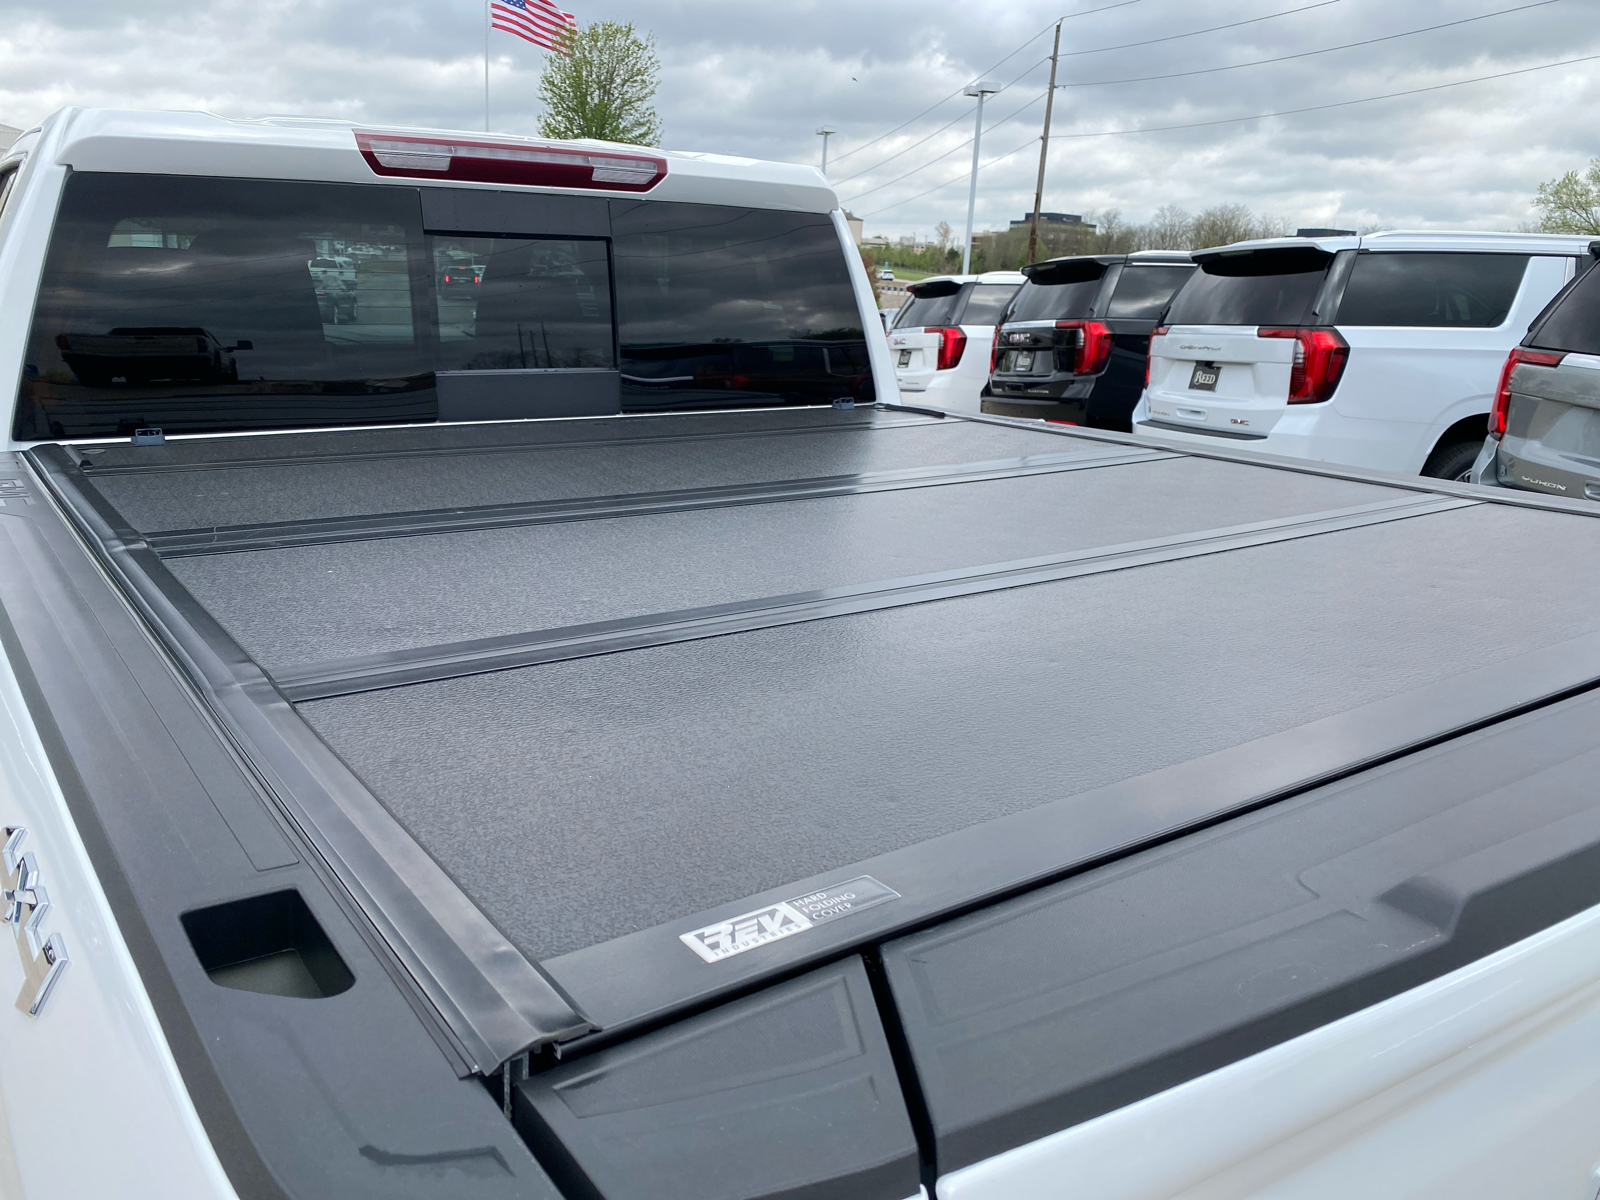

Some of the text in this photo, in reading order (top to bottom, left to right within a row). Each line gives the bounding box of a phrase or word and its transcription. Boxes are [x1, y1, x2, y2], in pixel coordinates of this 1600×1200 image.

[1009, 333, 1031, 343] GMC
[1193, 370, 1216, 385] REED
[1230, 418, 1250, 426] GMC
[1521, 475, 1567, 491] YUKON
[792, 891, 827, 907] HARD
[801, 891, 857, 913] FOLDING
[811, 902, 852, 920] COVER
[694, 909, 795, 951] REV
[713, 923, 802, 956] INDUSTRIES
